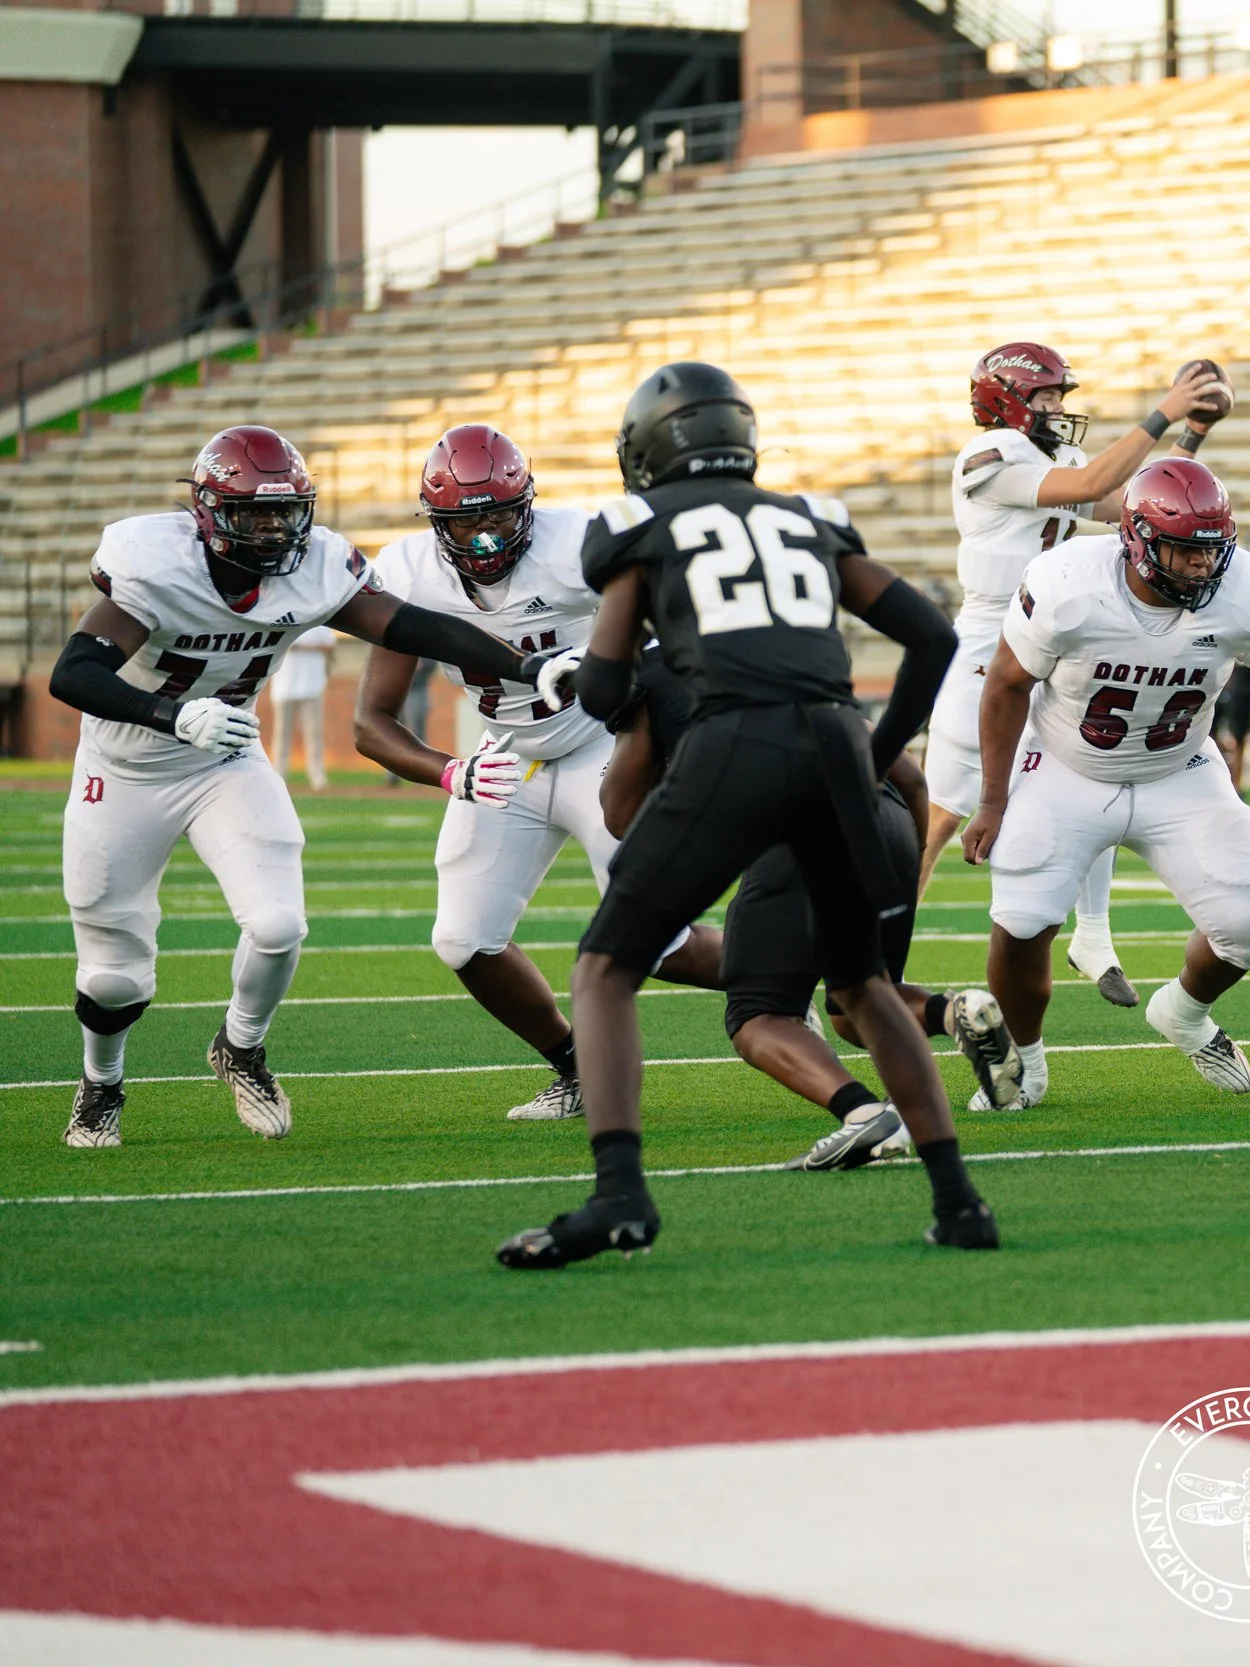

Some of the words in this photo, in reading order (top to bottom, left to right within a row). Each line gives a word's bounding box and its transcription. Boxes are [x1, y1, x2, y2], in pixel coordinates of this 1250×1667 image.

[986, 353, 1042, 373] Dothan
[262, 484, 292, 493] Riddell
[461, 495, 492, 506] Riddell
[669, 503, 834, 635] 26
[524, 604, 553, 614] adidas
[174, 631, 286, 653] DOTHAN
[1092, 661, 1209, 687] DOTHAN
[1020, 751, 1042, 773] D
[1185, 758, 1210, 770] adidas
[82, 772, 104, 804] D
